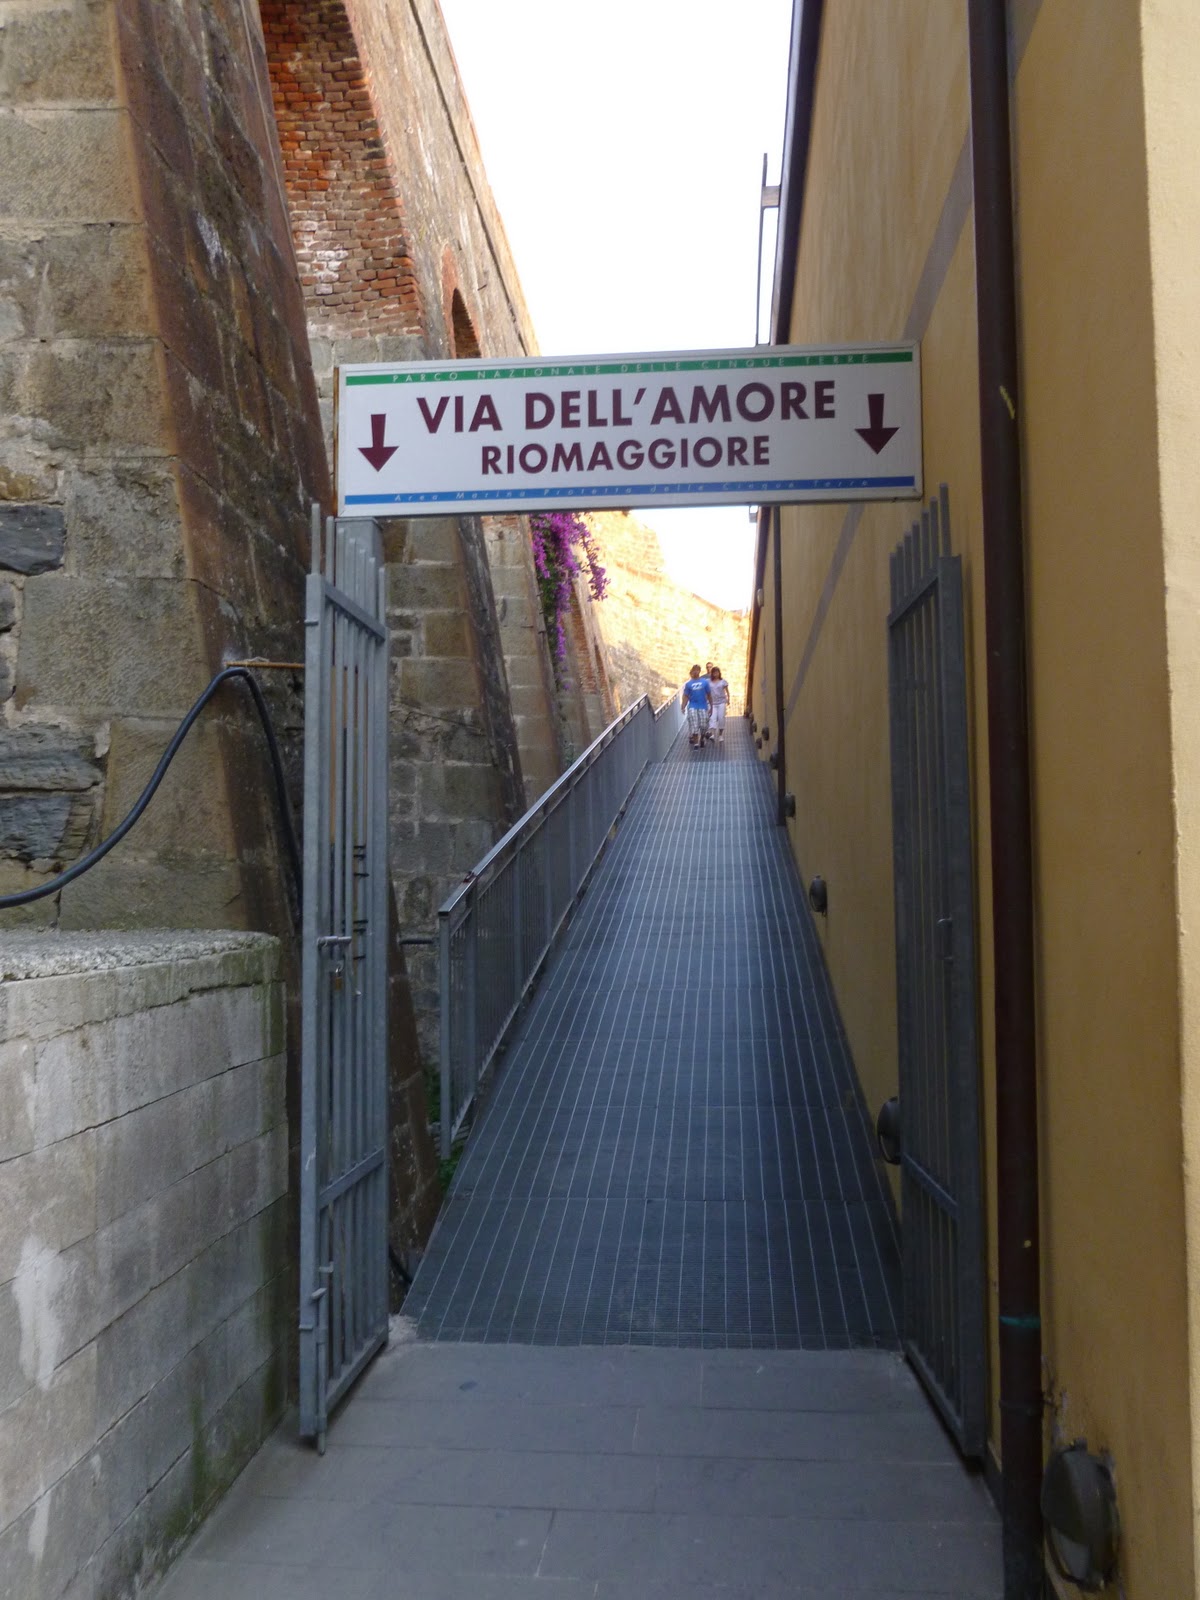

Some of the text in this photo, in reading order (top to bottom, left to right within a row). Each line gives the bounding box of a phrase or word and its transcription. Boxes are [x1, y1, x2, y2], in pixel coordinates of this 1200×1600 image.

[393, 354, 869, 383] PARCO NAZIONALE DELLE CINQUE TERRE
[416, 394, 503, 434] VIA
[481, 435, 770, 475] RIOMAGGIORE
[395, 479, 868, 502] Area Marina Protetta delle Cinque Terre
